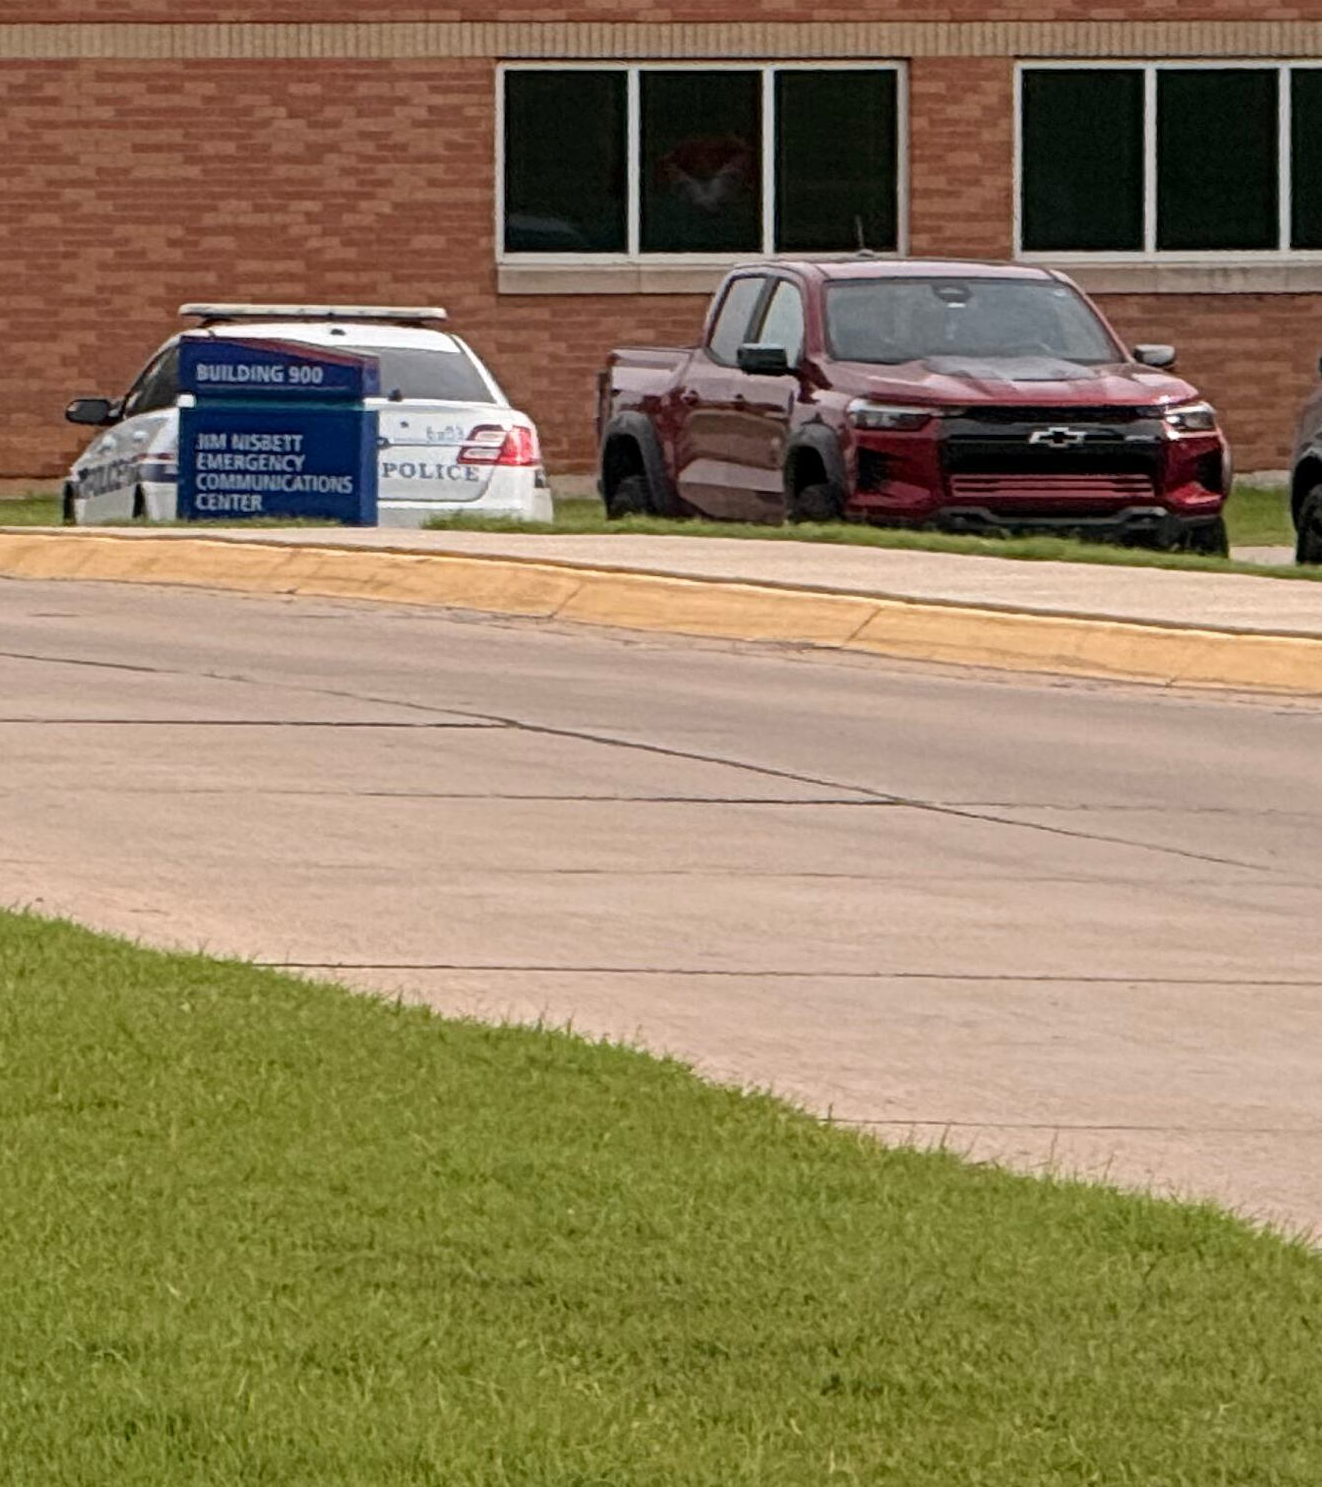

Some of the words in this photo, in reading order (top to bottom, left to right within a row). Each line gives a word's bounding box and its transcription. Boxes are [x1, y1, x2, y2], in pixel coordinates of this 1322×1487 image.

[196, 364, 284, 383] BUILDING
[288, 366, 324, 384] 900
[196, 433, 227, 451] JIM
[231, 434, 303, 452] NISBETT
[196, 453, 306, 471] EMERGENCY
[382, 462, 479, 481] POLICE
[196, 473, 353, 494] COMMUNICATIONS
[195, 493, 263, 512] CENTER
